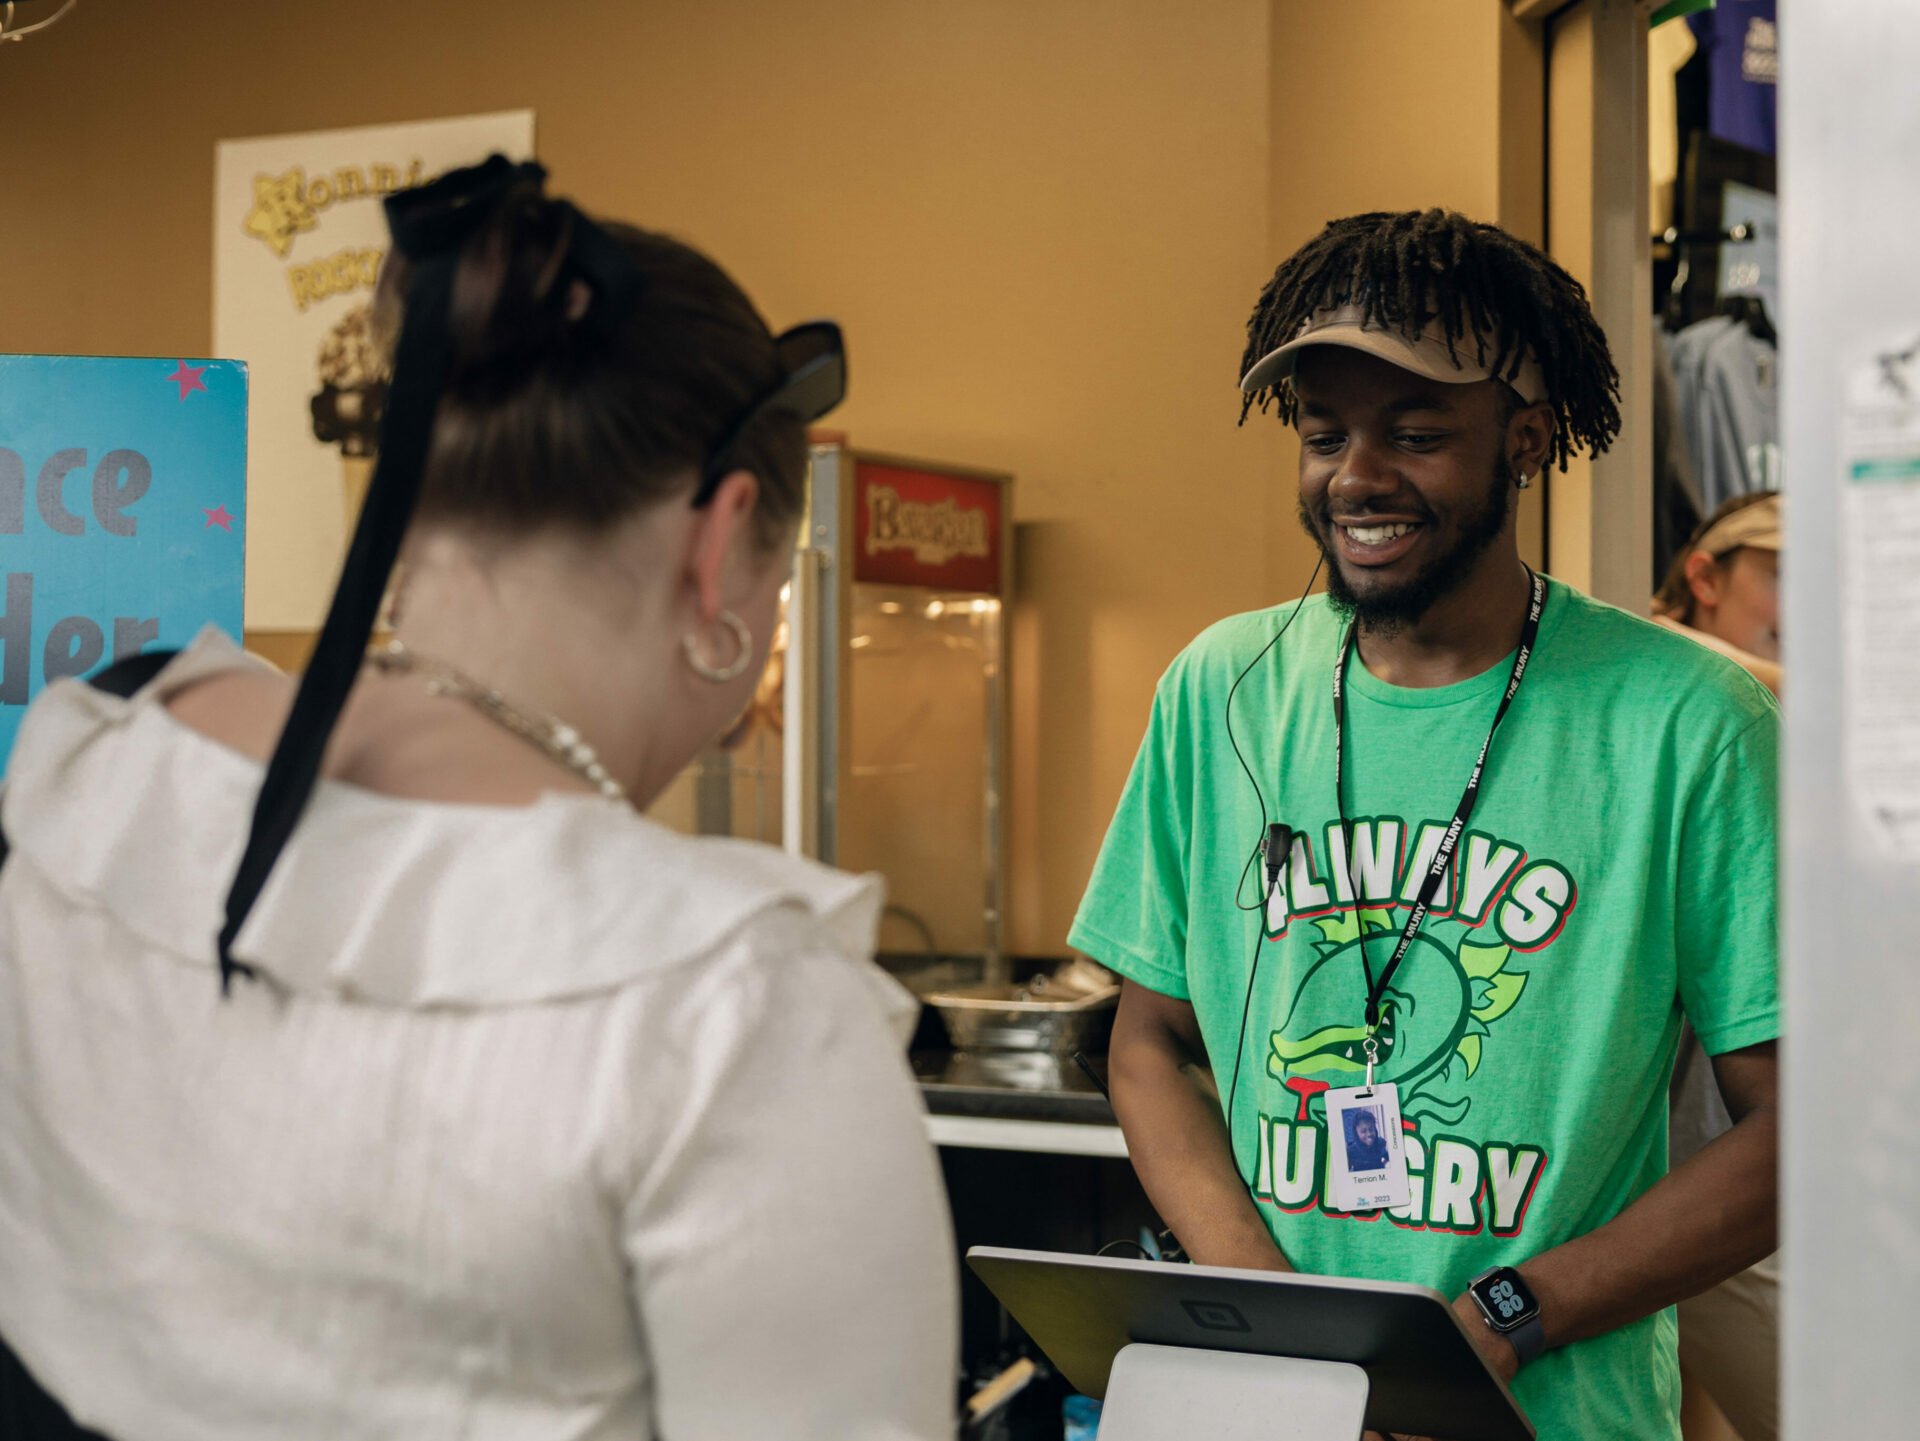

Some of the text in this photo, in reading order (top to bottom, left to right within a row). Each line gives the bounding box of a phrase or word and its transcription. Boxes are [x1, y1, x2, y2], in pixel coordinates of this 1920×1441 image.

[1530, 602, 1541, 622] THE
[1506, 645, 1530, 700] THE MUNY
[1468, 767, 1480, 789] THE
[1430, 816, 1464, 876] THE MUNY
[1395, 902, 1426, 960] THE MUNY
[1253, 1113, 1547, 1237] UGRY
[1374, 1194, 1391, 1203] 2023
